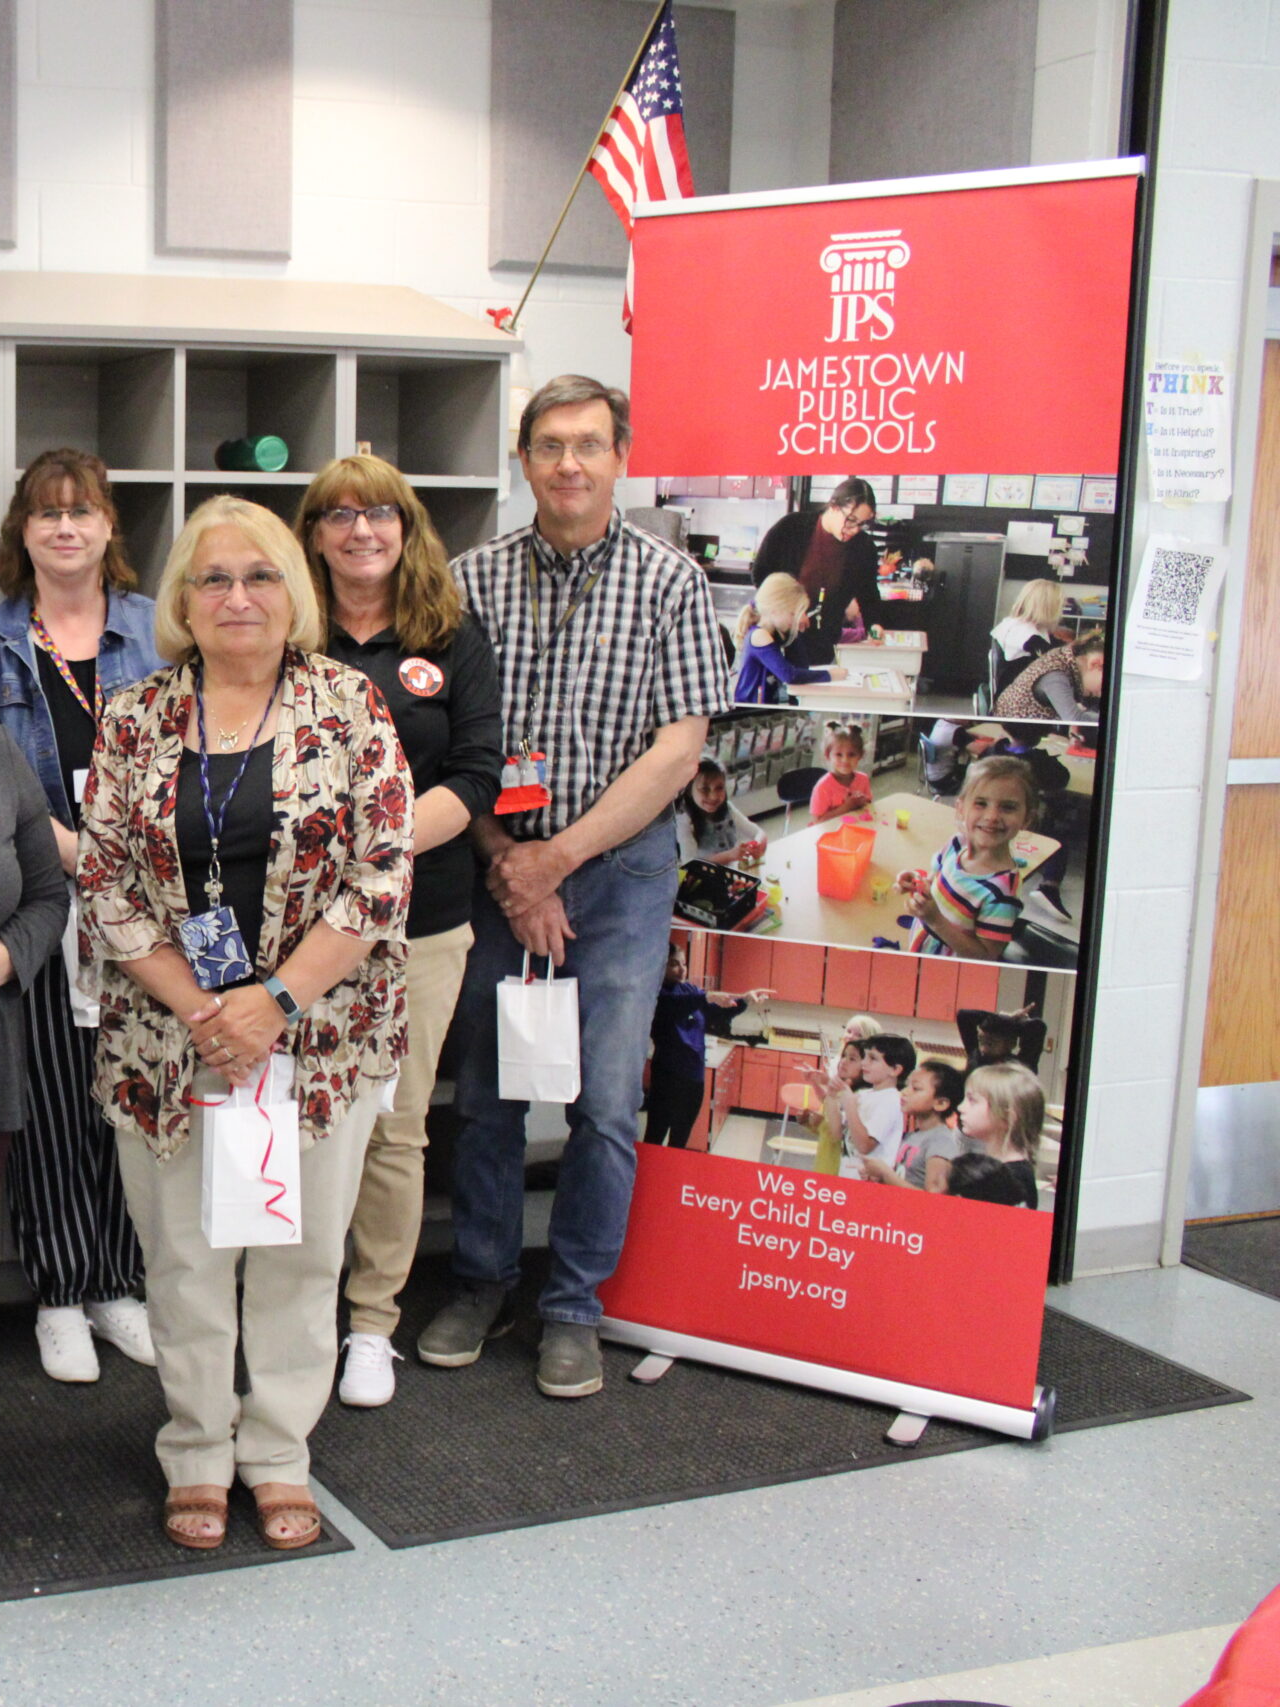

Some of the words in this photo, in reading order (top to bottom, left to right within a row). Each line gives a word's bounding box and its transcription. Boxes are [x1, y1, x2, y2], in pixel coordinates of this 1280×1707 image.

[825, 292, 895, 342] JPS
[759, 350, 965, 391] JAMESTOWN
[1148, 373, 1224, 395] THINK
[798, 387, 916, 421] PUBLIC
[1160, 406, 1167, 415] Is
[1168, 407, 1175, 416] it
[1178, 406, 1203, 416] True?
[777, 420, 937, 455] SCHOOLS
[1160, 427, 1168, 436] Is
[1169, 428, 1175, 436] it
[1176, 427, 1214, 438] Helpful?
[1163, 448, 1169, 457] it
[1157, 468, 1164, 477] Is
[1166, 469, 1172, 477] it
[1165, 488, 1173, 497] it
[757, 1170, 795, 1196] We
[803, 1179, 847, 1206] See
[680, 1185, 743, 1219] Every
[749, 1197, 810, 1228] Child
[818, 1211, 924, 1255] Learning
[737, 1224, 801, 1259] Every
[809, 1237, 855, 1270] Day
[738, 1263, 847, 1309] jpsny.org
